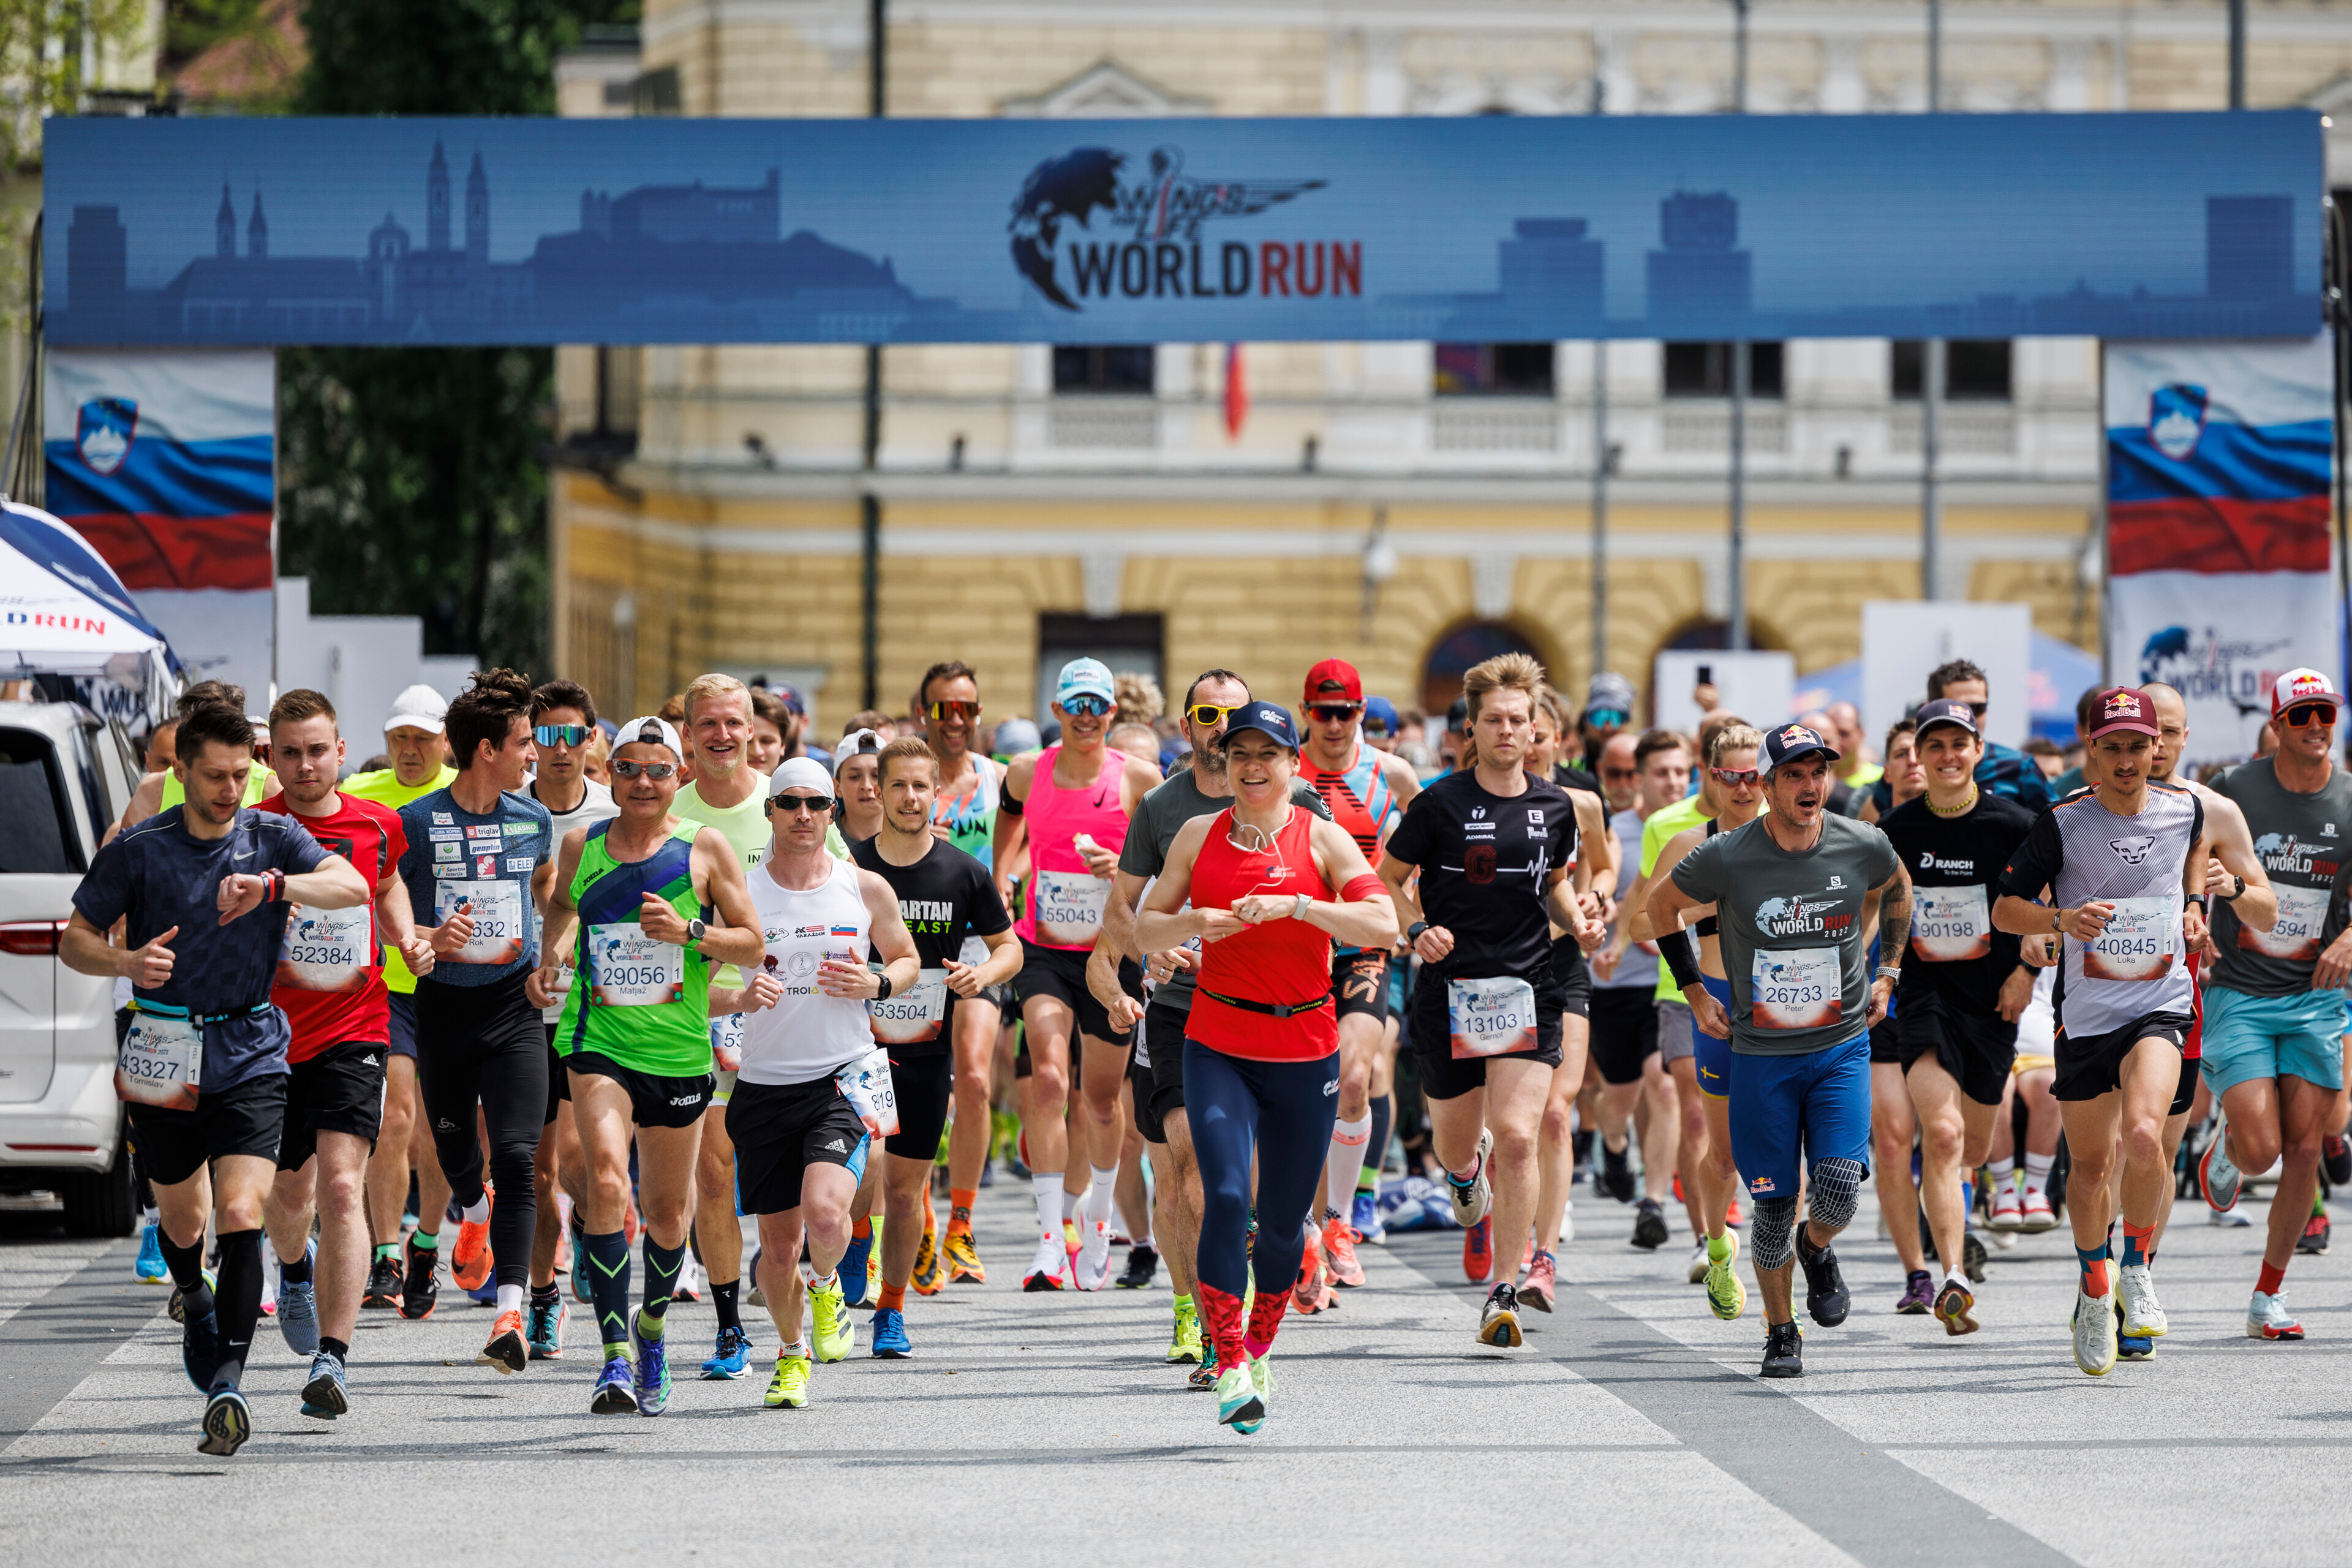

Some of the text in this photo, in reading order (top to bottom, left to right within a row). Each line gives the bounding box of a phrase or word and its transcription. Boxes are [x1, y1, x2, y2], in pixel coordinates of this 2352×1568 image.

[2105, 707, 2141, 719] Red Bull
[1783, 736, 1801, 748] Red
[478, 827, 500, 837] triglav
[513, 823, 537, 833] LAŠKO
[472, 842, 500, 853] geoplin
[517, 859, 532, 869] ELES
[1936, 859, 1973, 870] RANCH
[899, 900, 952, 921] ARTAN
[1785, 903, 1820, 913] WINGS
[1046, 907, 1096, 924] 55043
[1790, 911, 1811, 921] LIFE
[472, 921, 505, 938] 632
[514, 924, 519, 935] 1
[904, 920, 952, 933] EAST
[1921, 922, 1973, 937] 90198
[2271, 920, 2307, 937] 594
[2269, 934, 2290, 943] David
[2097, 938, 2156, 955] 40845
[2166, 940, 2170, 951] 1
[291, 946, 352, 965] 52384
[674, 967, 679, 979] 1
[1786, 963, 1811, 972] WINGS
[603, 967, 665, 986] 29056
[619, 986, 647, 996] Matjaž
[1480, 992, 1505, 1001] WINGS
[1766, 985, 1822, 1004] 26733
[1831, 986, 1839, 997] 2
[873, 1001, 927, 1020] 53504
[1464, 1013, 1517, 1033] 13103
[1526, 1013, 1532, 1024] 1
[142, 1031, 168, 1043] WINGS
[1480, 1032, 1503, 1041] Gernot
[144, 1039, 160, 1048] LIFE
[121, 1054, 179, 1080] 43327
[190, 1068, 196, 1081] 1
[129, 1075, 164, 1088] Tomislav
[824, 1144, 848, 1155] adidas
[1751, 1183, 1775, 1194] Red Bull
